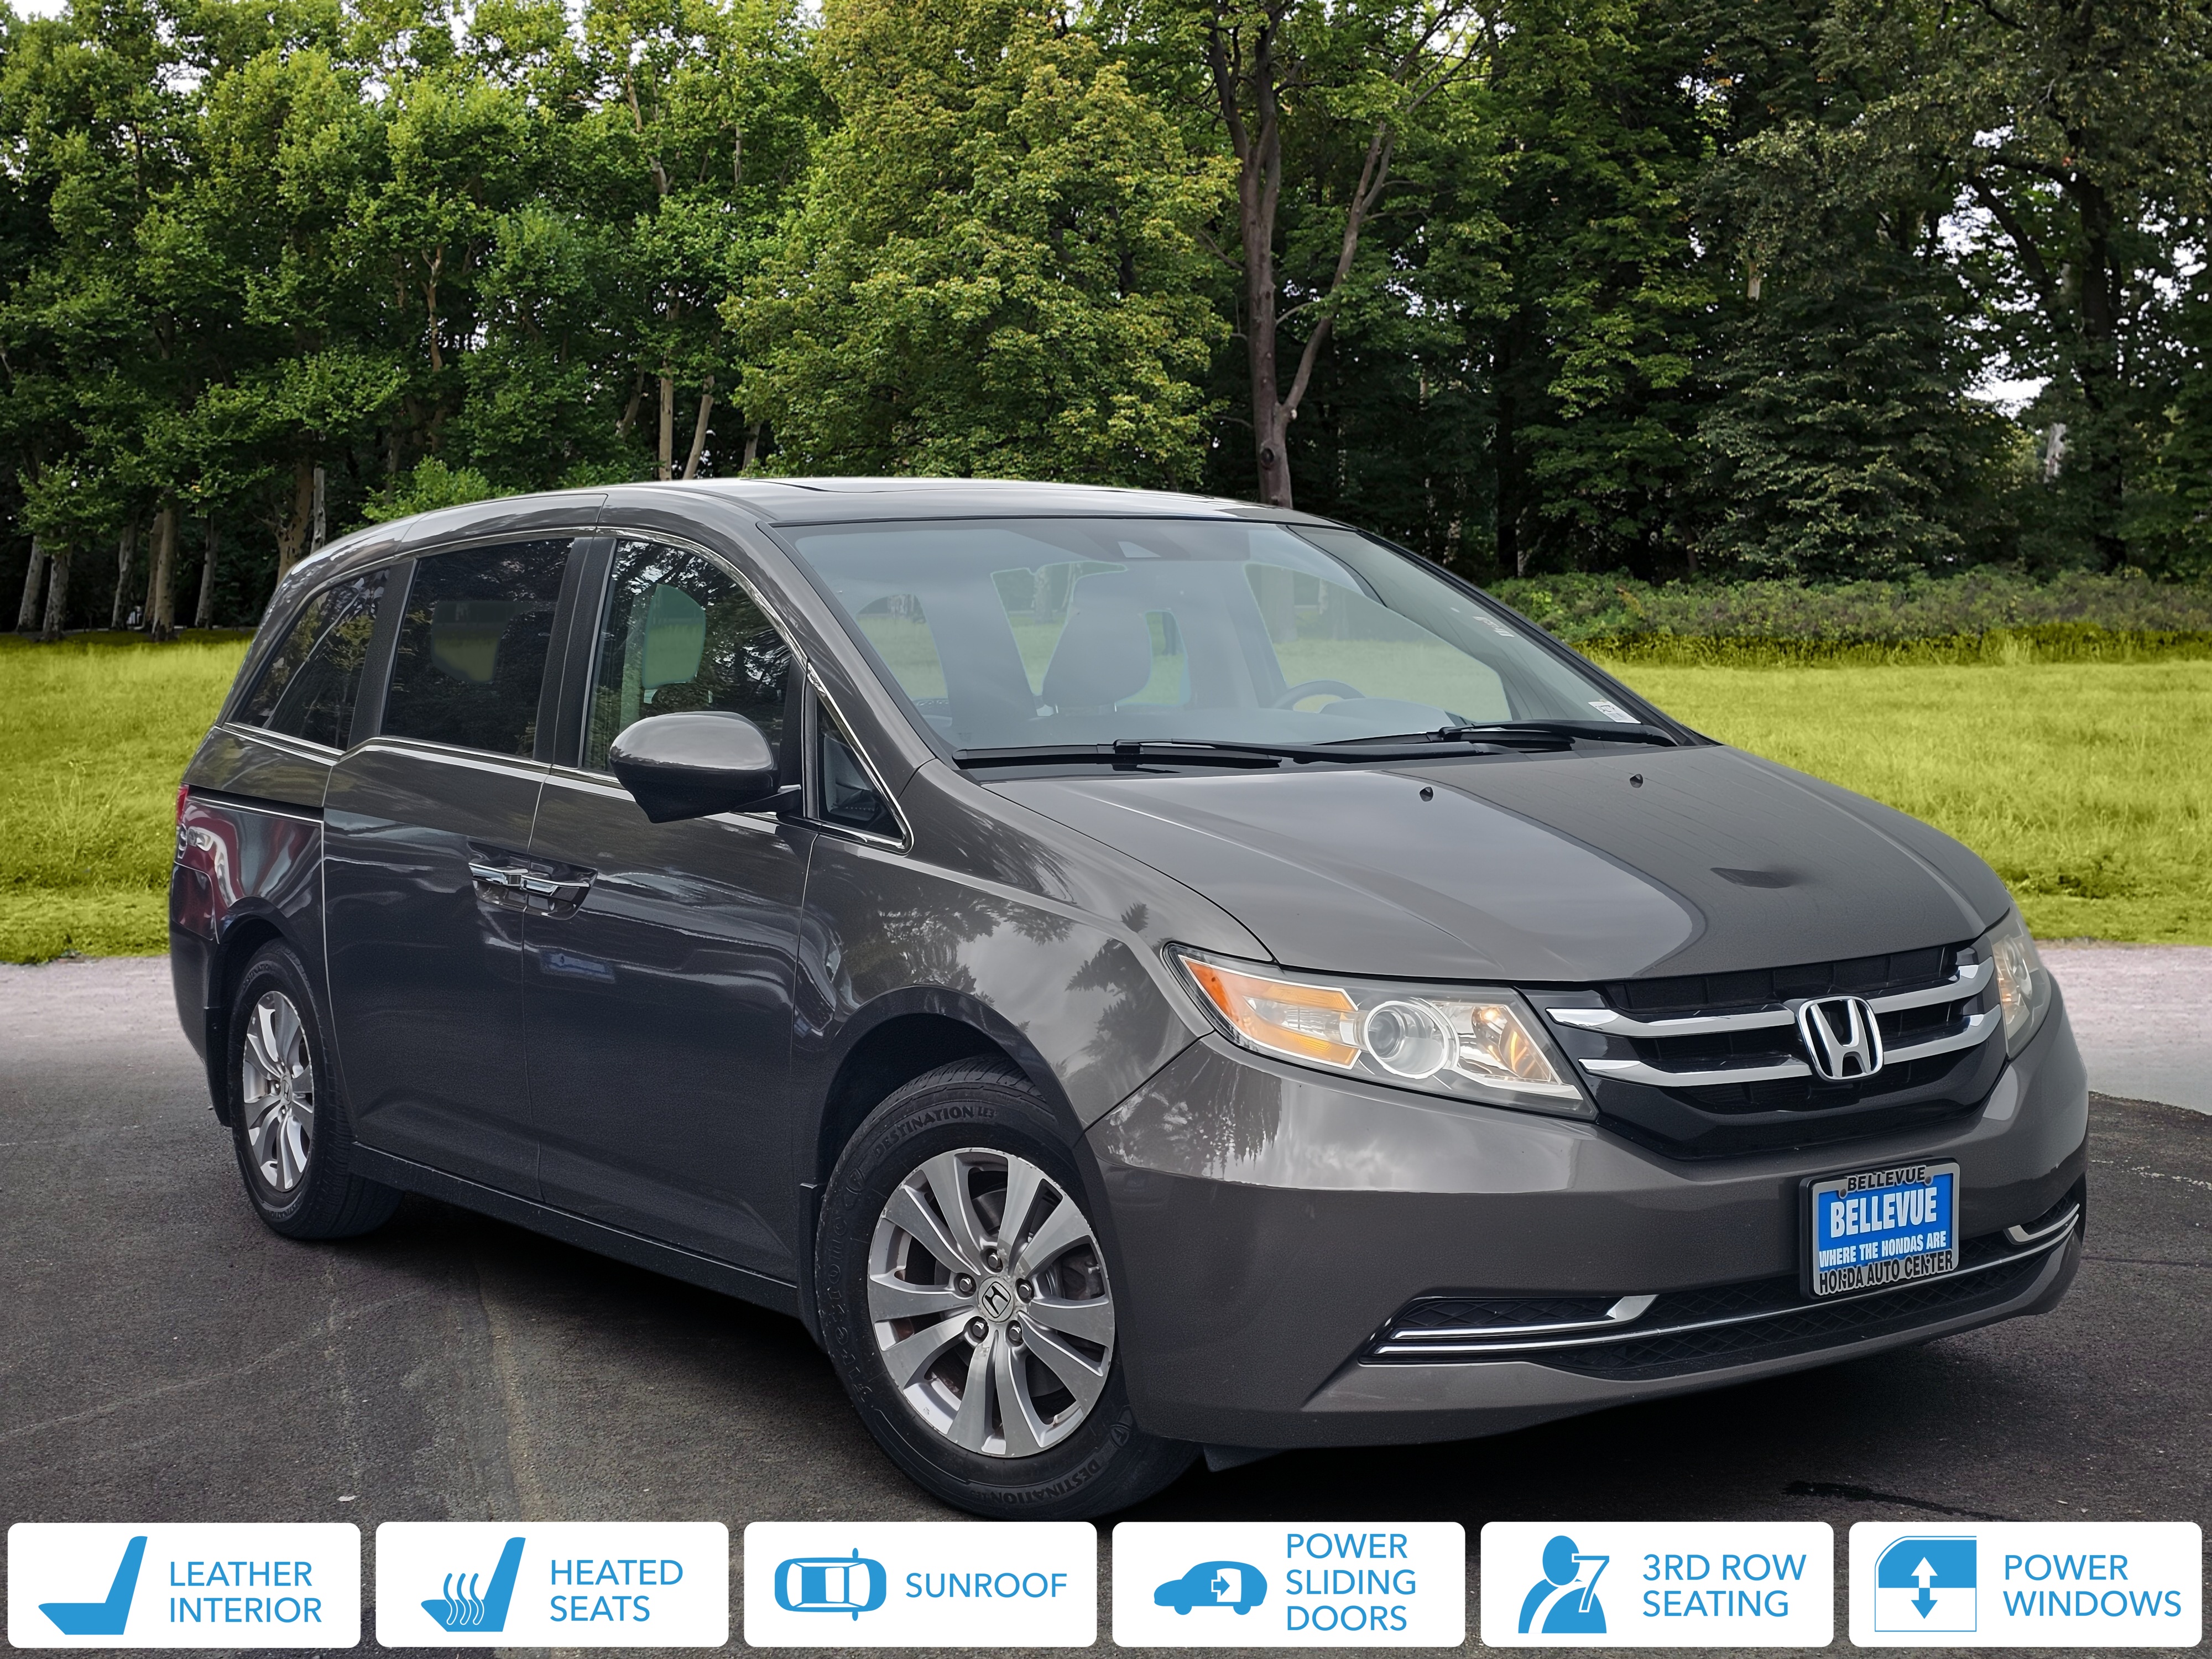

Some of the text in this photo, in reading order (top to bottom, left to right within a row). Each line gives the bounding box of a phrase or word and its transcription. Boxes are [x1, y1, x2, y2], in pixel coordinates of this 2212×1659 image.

[873, 1106, 974, 1159] DESTINATION
[1848, 1167, 1926, 1192] BELLEVUE
[1830, 1187, 1937, 1238] BELLEVUE
[1819, 1230, 1947, 1268] WHERE THE HONDAS ARE
[1819, 1250, 1953, 1294] HONDA AUTO CENTER
[990, 1458, 1102, 1504] DESTINATION
